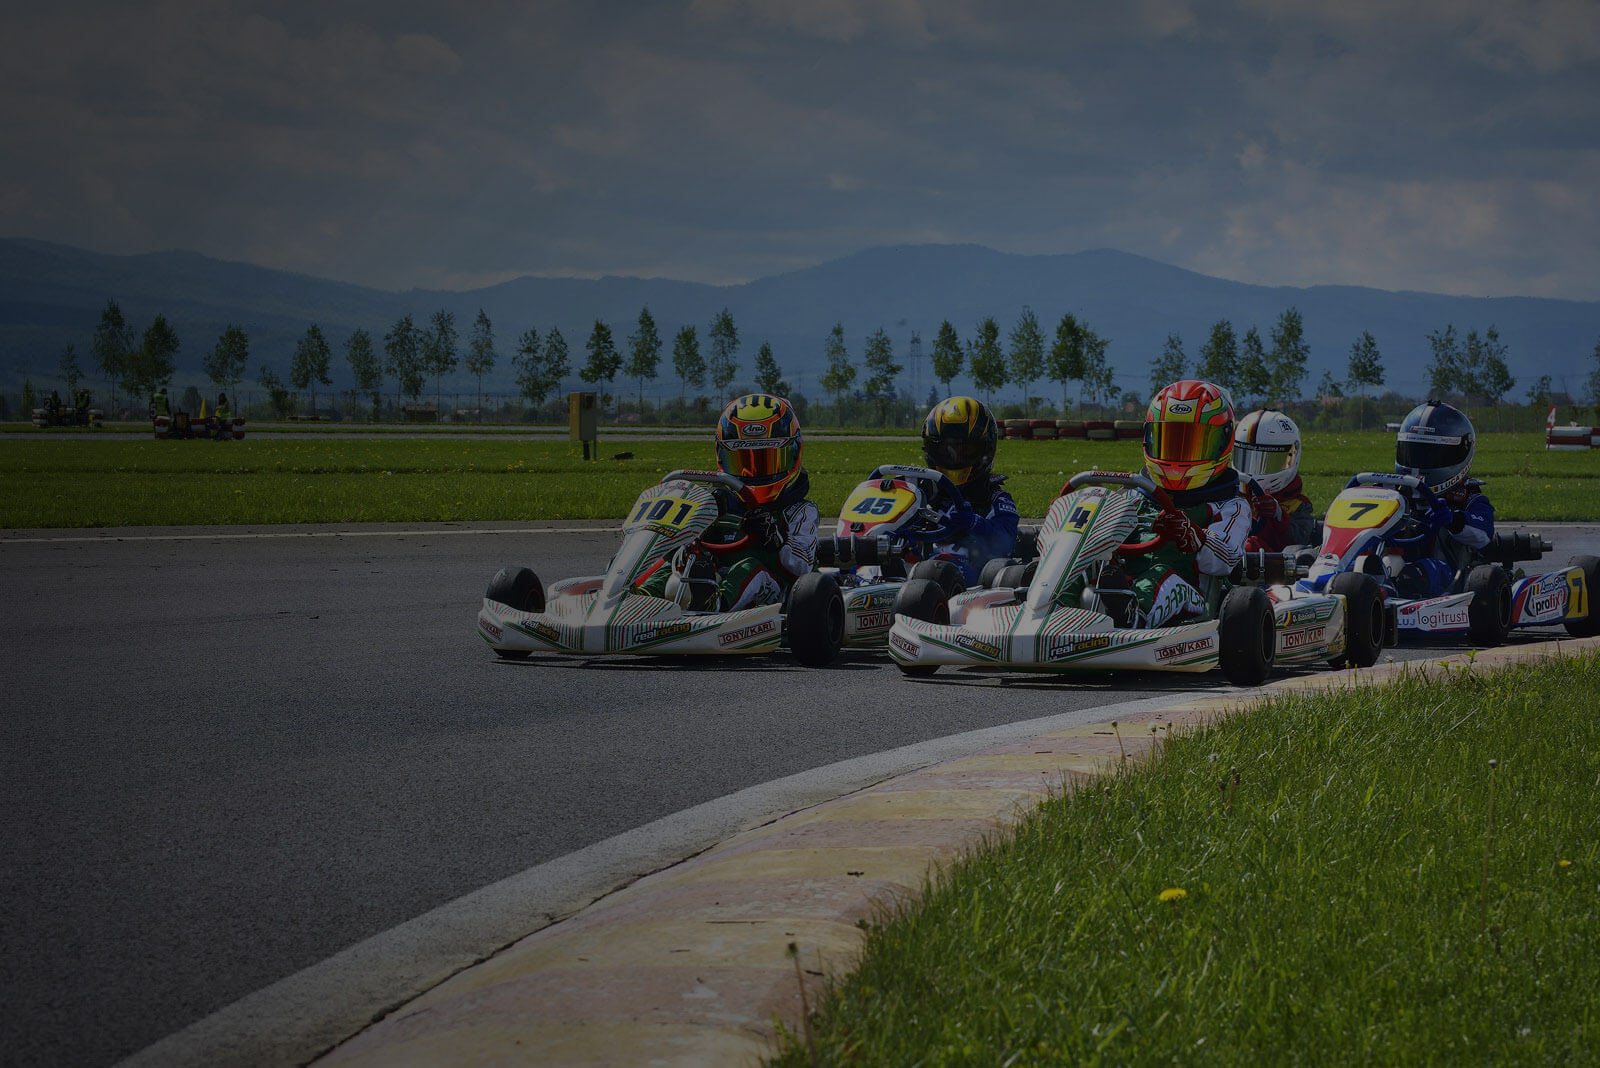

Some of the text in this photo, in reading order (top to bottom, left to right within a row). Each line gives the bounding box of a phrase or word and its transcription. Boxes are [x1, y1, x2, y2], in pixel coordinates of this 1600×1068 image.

[1171, 404, 1190, 412] Arai
[1547, 407, 1556, 425] 4
[744, 424, 765, 433] Arai
[1440, 476, 1461, 491] LUCA
[632, 499, 693, 526] 101
[851, 497, 898, 516] 45
[1348, 503, 1379, 521] 7
[1069, 506, 1091, 529] 4
[1535, 591, 1563, 616] profix
[1572, 577, 1583, 613] 7
[857, 613, 880, 628] TONY
[721, 621, 775, 646] TONY KART
[1281, 626, 1326, 649] TONY KART
[1156, 638, 1212, 660] TONY KART
